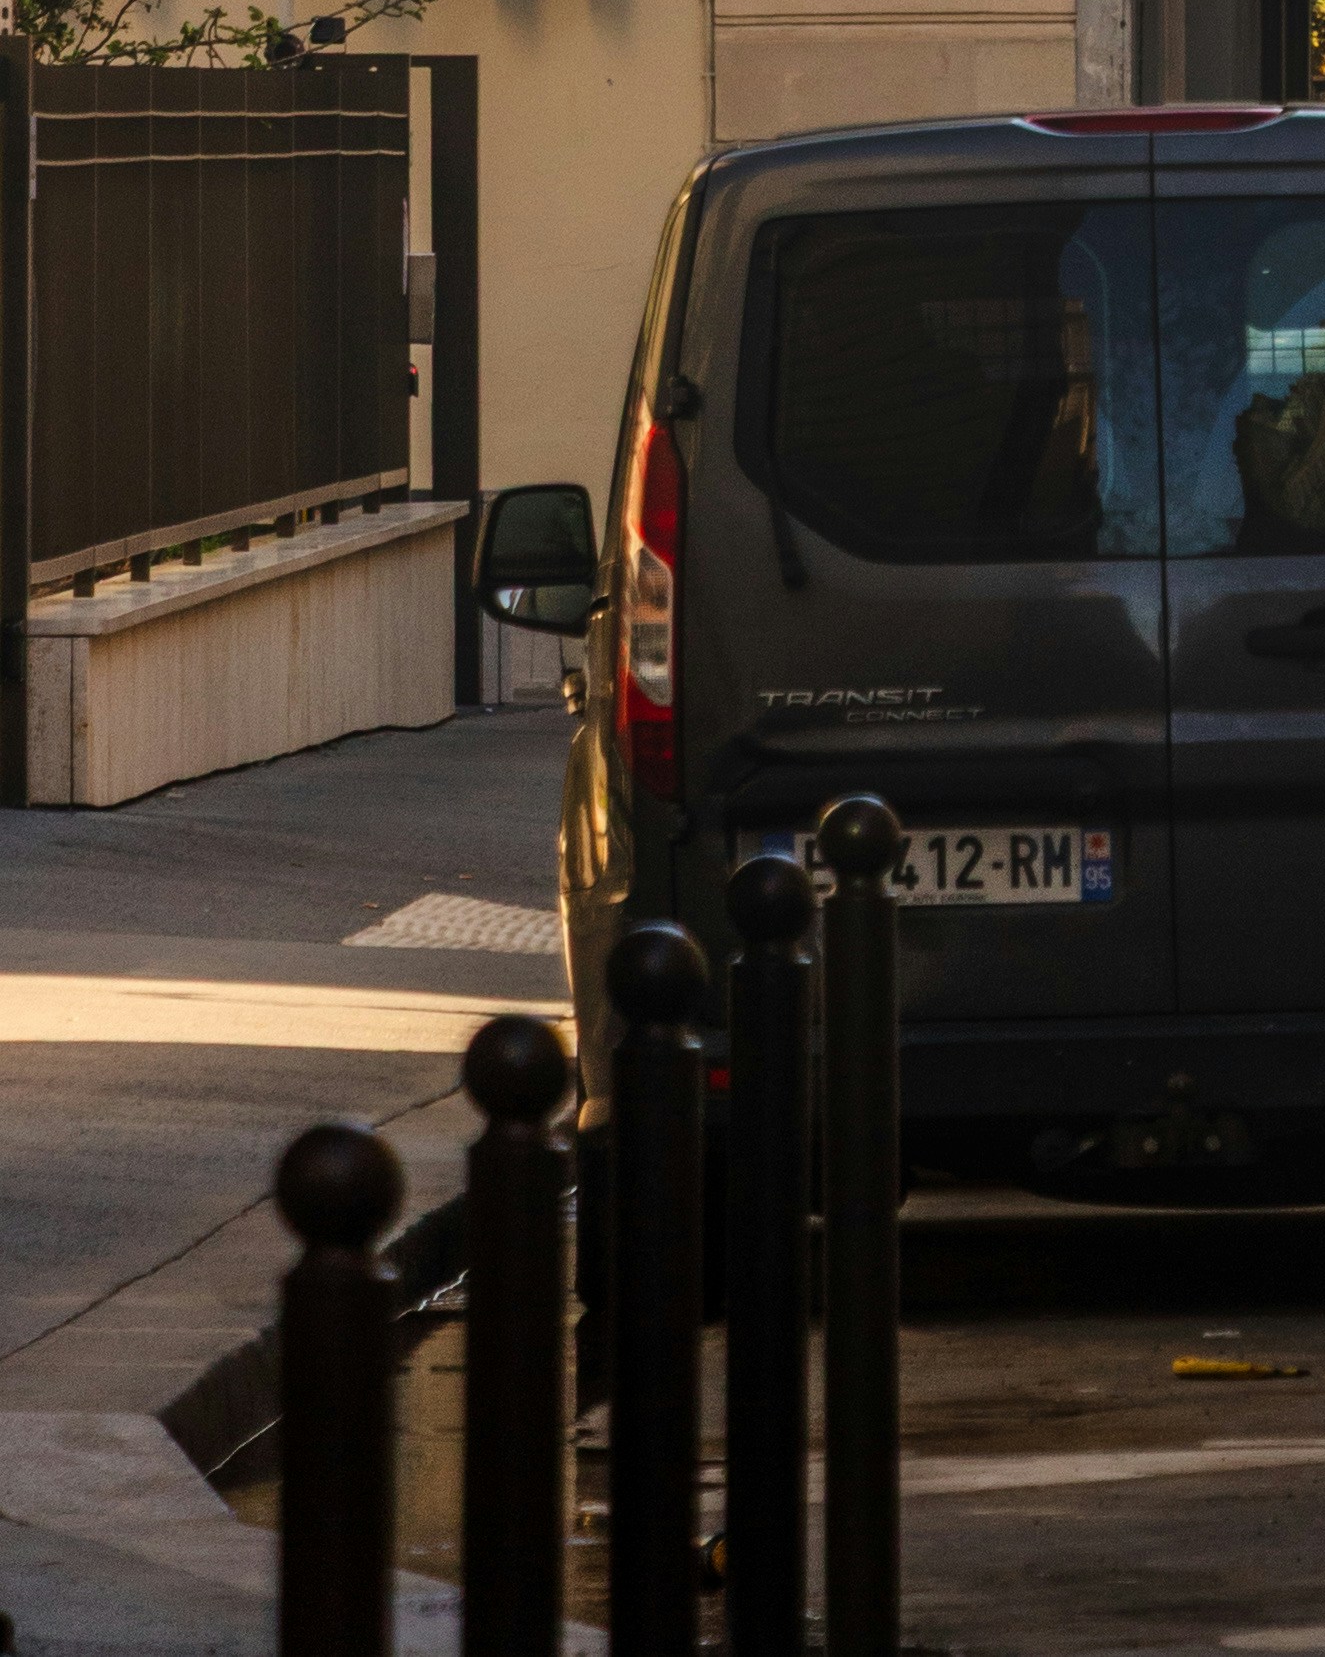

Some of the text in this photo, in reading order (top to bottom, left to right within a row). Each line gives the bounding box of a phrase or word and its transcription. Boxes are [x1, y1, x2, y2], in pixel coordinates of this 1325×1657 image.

[757, 688, 944, 707] TRANSIT
[846, 707, 985, 723] CONNECT
[1085, 865, 1112, 890] 95
